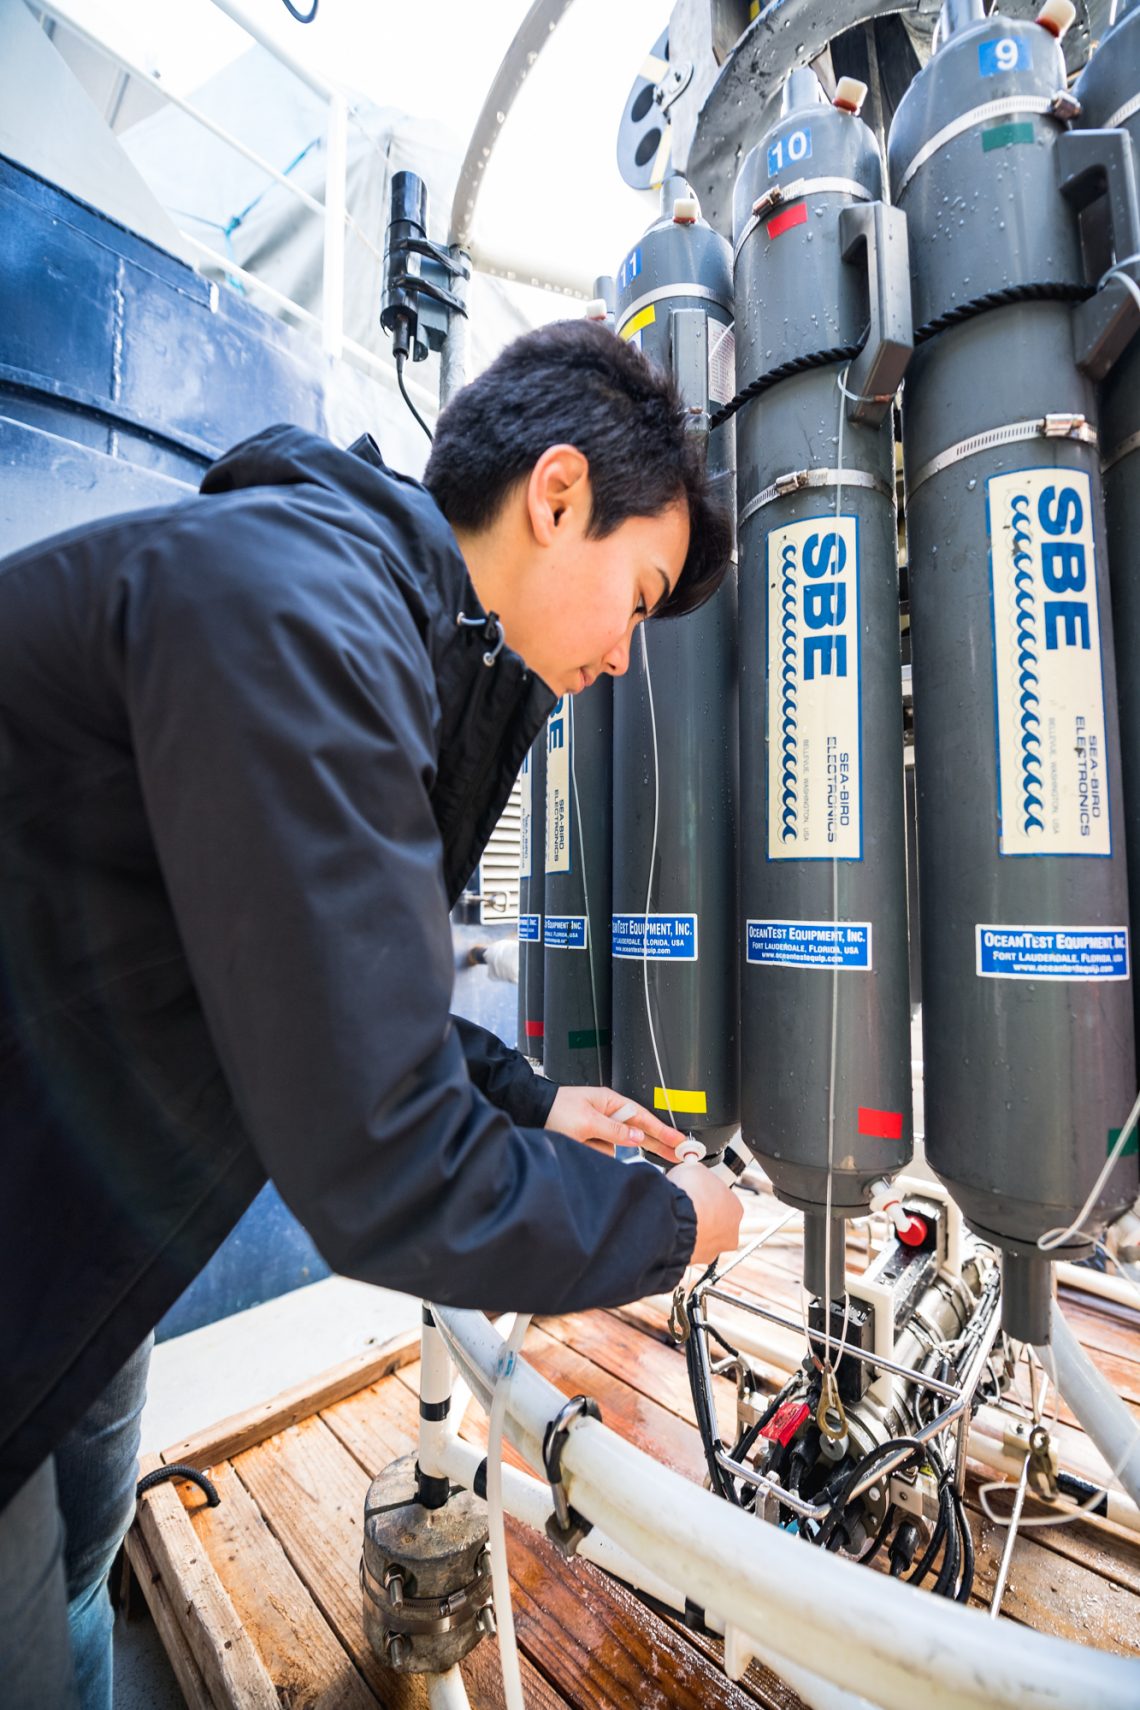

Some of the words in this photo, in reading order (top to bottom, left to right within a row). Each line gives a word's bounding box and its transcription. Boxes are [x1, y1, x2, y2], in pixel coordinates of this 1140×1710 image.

[995, 38, 1019, 71] 9
[771, 131, 808, 168] 10
[620, 251, 637, 288] 11
[1037, 485, 1091, 650] SBE
[802, 532, 847, 680] SBE
[827, 736, 837, 842] ELECTRONICS
[840, 752, 849, 826] SEA-BIRD
[1076, 716, 1090, 837] ELECTRONICS
[1089, 735, 1101, 818] SEA-BIRD
[629, 920, 673, 937] EQUIPMENT,
[675, 920, 693, 936] INC.
[671, 939, 685, 947] USA
[749, 926, 787, 939] OCEANTEST
[789, 927, 845, 944] EQUIPMENT,
[847, 929, 866, 943] INC.
[984, 932, 1054, 949] OCEANTEST
[752, 941, 764, 950] FORT
[844, 946, 859, 955] USA
[992, 951, 1016, 961] FORT
